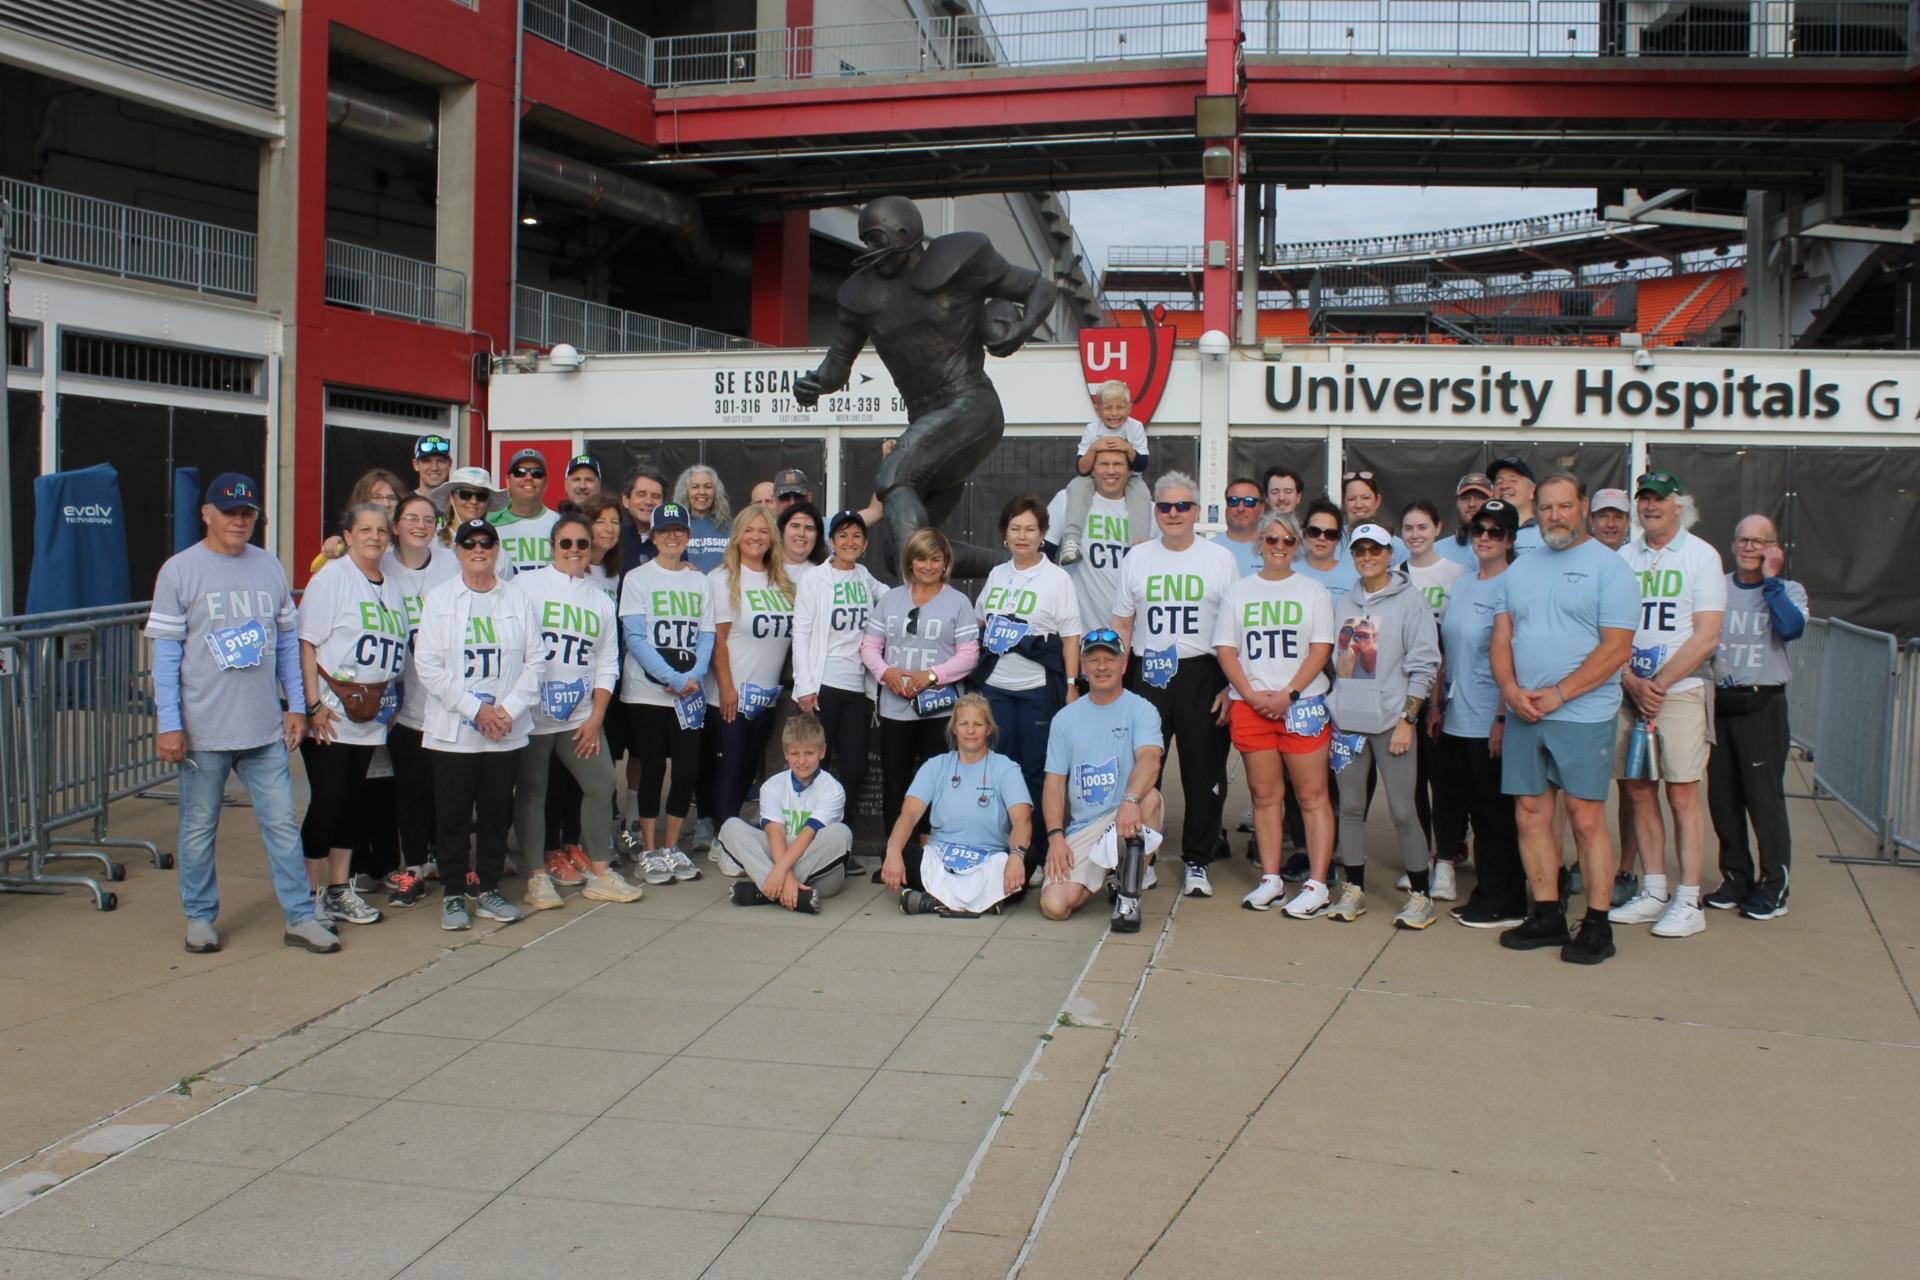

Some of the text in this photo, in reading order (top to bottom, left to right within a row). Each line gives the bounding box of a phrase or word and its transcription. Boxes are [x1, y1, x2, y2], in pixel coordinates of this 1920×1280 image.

[1087, 341, 1127, 371] UH
[715, 371, 736, 394] SE
[715, 399, 760, 414] 301-316
[829, 397, 880, 412] 324-339
[1265, 366, 1554, 426] University
[1576, 369, 1841, 429] Hospitals
[64, 504, 112, 517] evolv
[688, 538, 729, 547] NCUSSIO
[833, 581, 868, 605] END
[1145, 574, 1204, 602] END
[206, 590, 273, 619] END
[652, 590, 702, 618] END
[1243, 600, 1303, 627] END
[541, 600, 600, 639] END
[831, 607, 869, 631] CTE
[1147, 606, 1199, 635] CTE
[1641, 602, 1677, 631] TE
[1729, 610, 1769, 636] ND
[225, 628, 259, 652] 9159
[464, 616, 497, 645] EN
[654, 620, 699, 648] CTE
[995, 628, 1019, 639] 9110
[355, 634, 405, 674] CTE
[541, 631, 594, 667] CTE
[1246, 629, 1298, 660] CTE
[1145, 658, 1172, 671] 9134
[1629, 656, 1651, 670] 142
[554, 691, 580, 703] 9117
[687, 697, 704, 715] 9115
[926, 697, 951, 711] 9143
[1297, 704, 1325, 720] 9148
[1082, 773, 1115, 788] 10033
[951, 847, 980, 861] 9153
